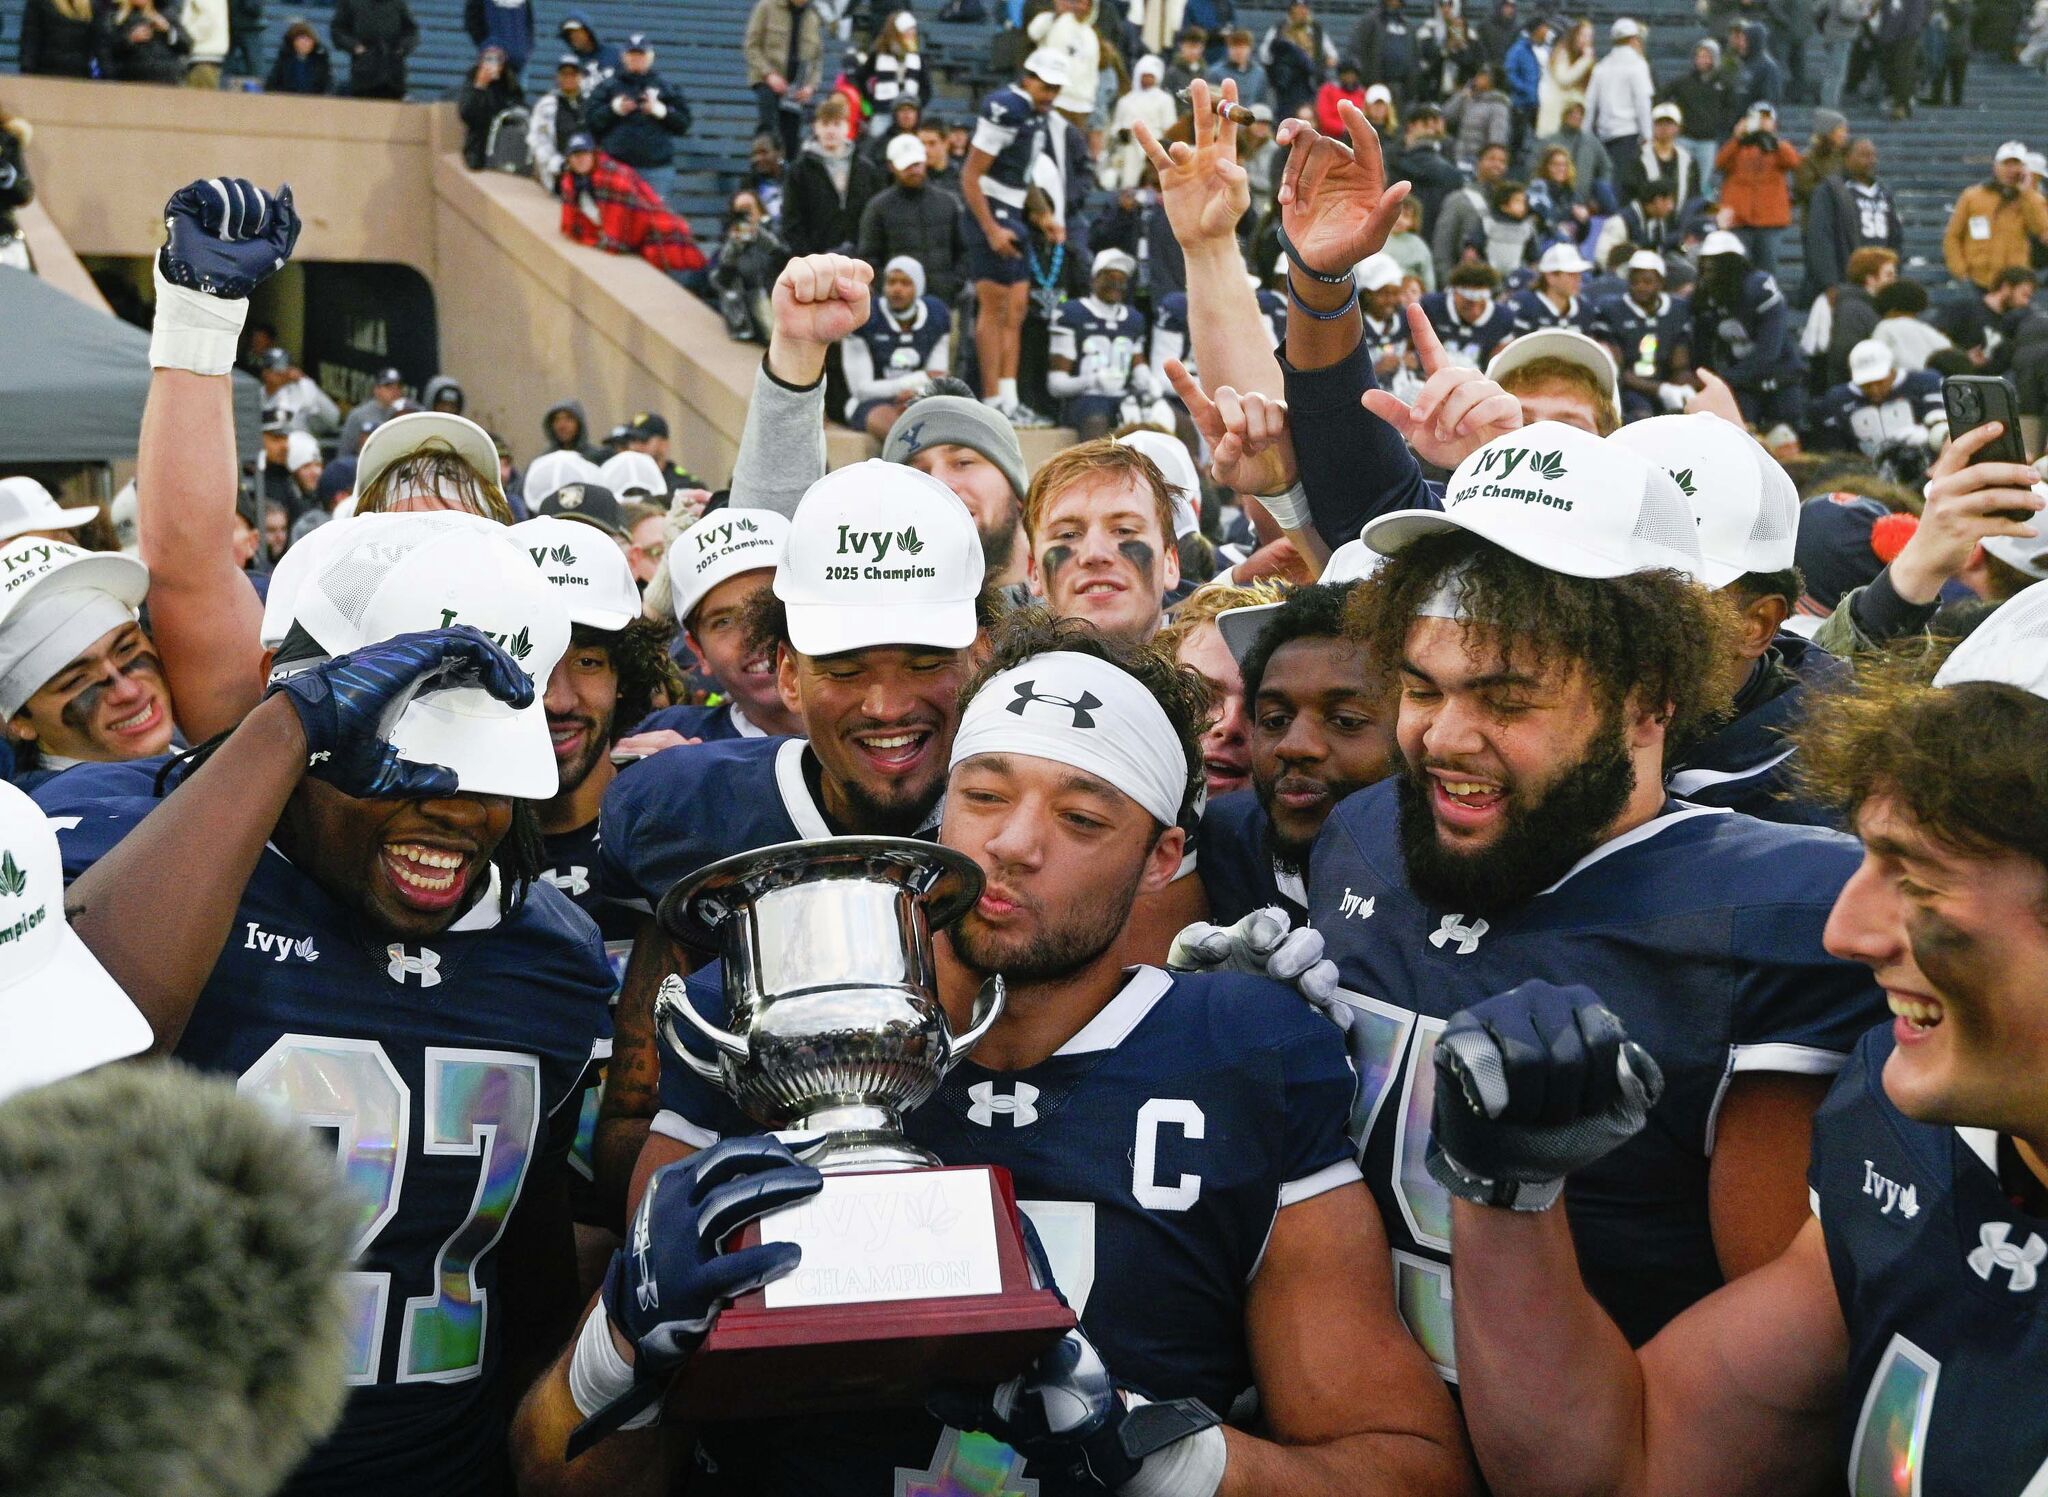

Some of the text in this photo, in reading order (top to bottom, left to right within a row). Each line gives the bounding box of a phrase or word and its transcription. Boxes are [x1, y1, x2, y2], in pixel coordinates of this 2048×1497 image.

[200, 284, 217, 294] UA
[1470, 448, 1530, 480] Ivy
[1451, 484, 1574, 512] 2025 Champions
[695, 522, 733, 553] Ivy
[836, 525, 893, 563] Ivy
[3, 545, 51, 573] Ivy
[696, 538, 774, 574] 2025 Champions
[5, 570, 35, 592] 2025
[547, 573, 589, 586] mpions
[825, 564, 935, 581] 2025 Champions
[1338, 887, 1364, 919] Ivy
[244, 922, 294, 962] Ivy
[1131, 1098, 1205, 1212] C
[1862, 1159, 1901, 1215] Ivy
[794, 1192, 904, 1253] Ivy
[795, 1259, 973, 1298] CHAMPION
